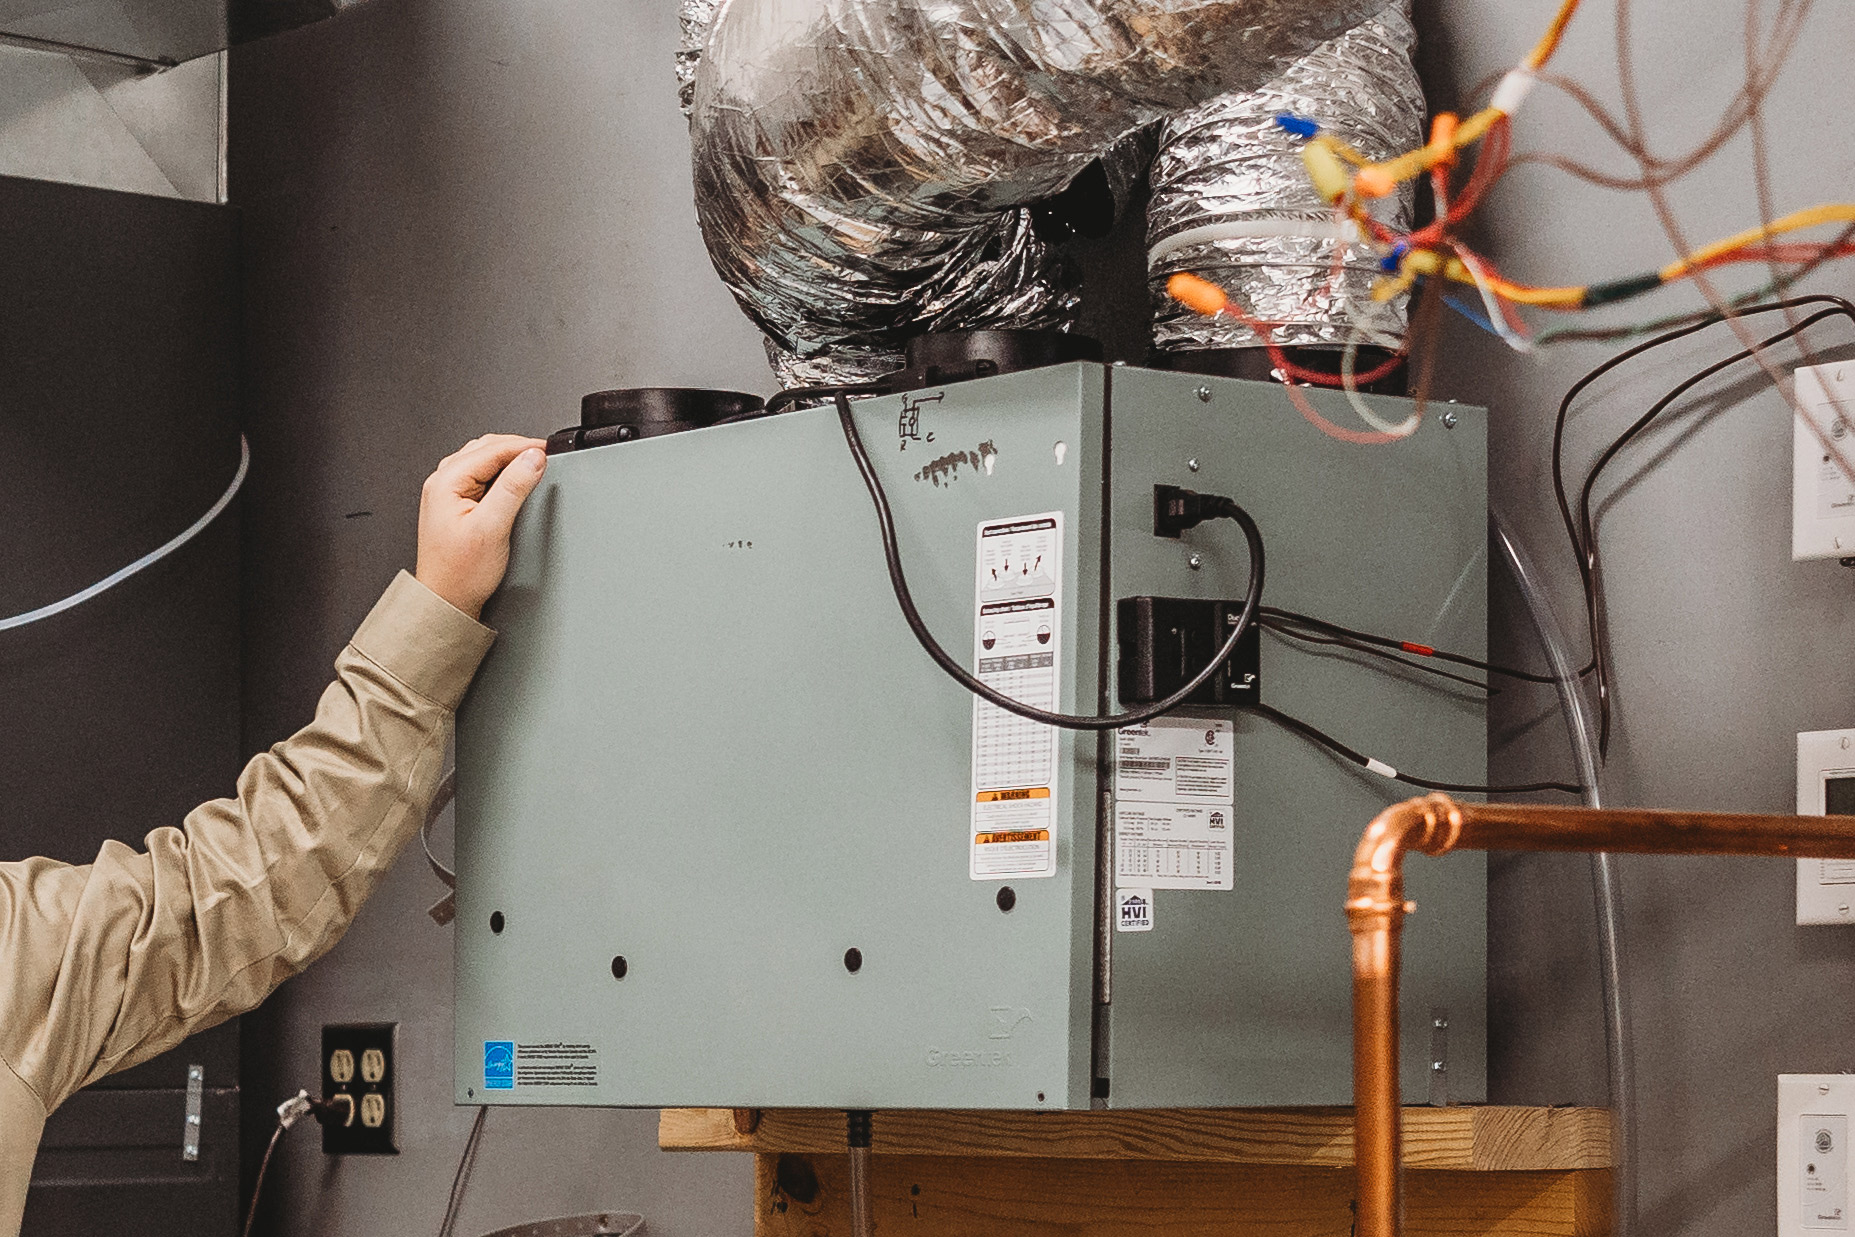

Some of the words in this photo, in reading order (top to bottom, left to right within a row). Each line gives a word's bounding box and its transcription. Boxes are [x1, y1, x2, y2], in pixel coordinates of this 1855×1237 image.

[925, 431, 936, 443] C
[1121, 906, 1147, 919] HVI
[1121, 919, 1150, 927] CERTIFIED
